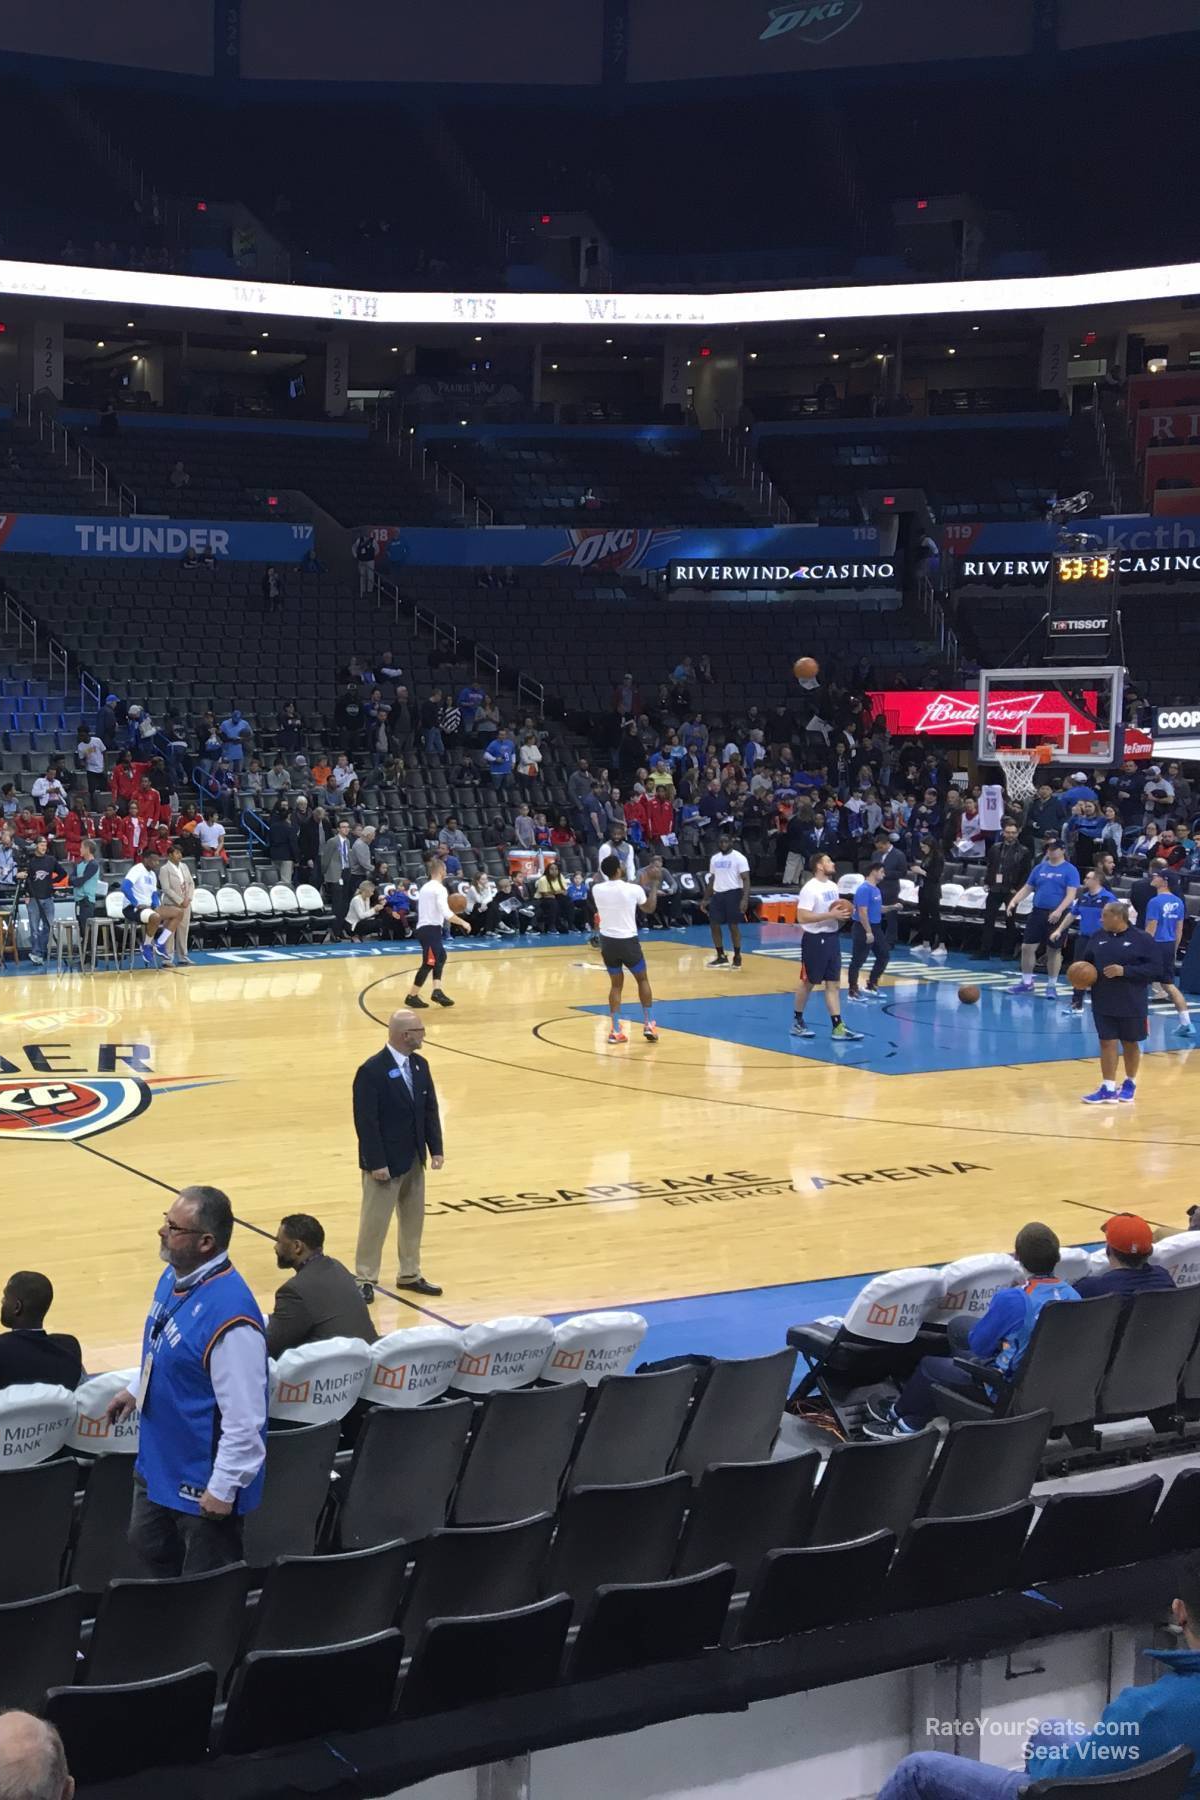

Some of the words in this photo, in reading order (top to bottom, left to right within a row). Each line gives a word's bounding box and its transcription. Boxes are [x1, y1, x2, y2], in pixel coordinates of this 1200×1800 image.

[44, 338, 54, 378] 225
[333, 357, 342, 396] 225
[75, 524, 230, 555] THUNDER
[291, 525, 313, 539] 117
[370, 528, 388, 542] 18
[852, 528, 877, 540] 118
[945, 526, 972, 538] 119
[576, 529, 632, 567] OKC
[676, 565, 790, 580] RIVERWIND
[810, 563, 894, 579] CASINO
[964, 560, 1050, 576] RIVERW
[1069, 619, 1108, 630] TISSOT
[986, 798, 997, 810] 13
[681, 873, 693, 887] G
[290, 942, 492, 957] paycm
[810, 1160, 992, 1190] ARENA
[666, 1183, 800, 1207] ENERGY
[491, 1362, 525, 1376] BANK
[584, 1358, 619, 1371] BANK
[408, 1376, 438, 1390] BANK
[312, 1389, 348, 1405] BANK
[114, 1422, 139, 1437] BAN
[3, 1438, 41, 1456] BANK
